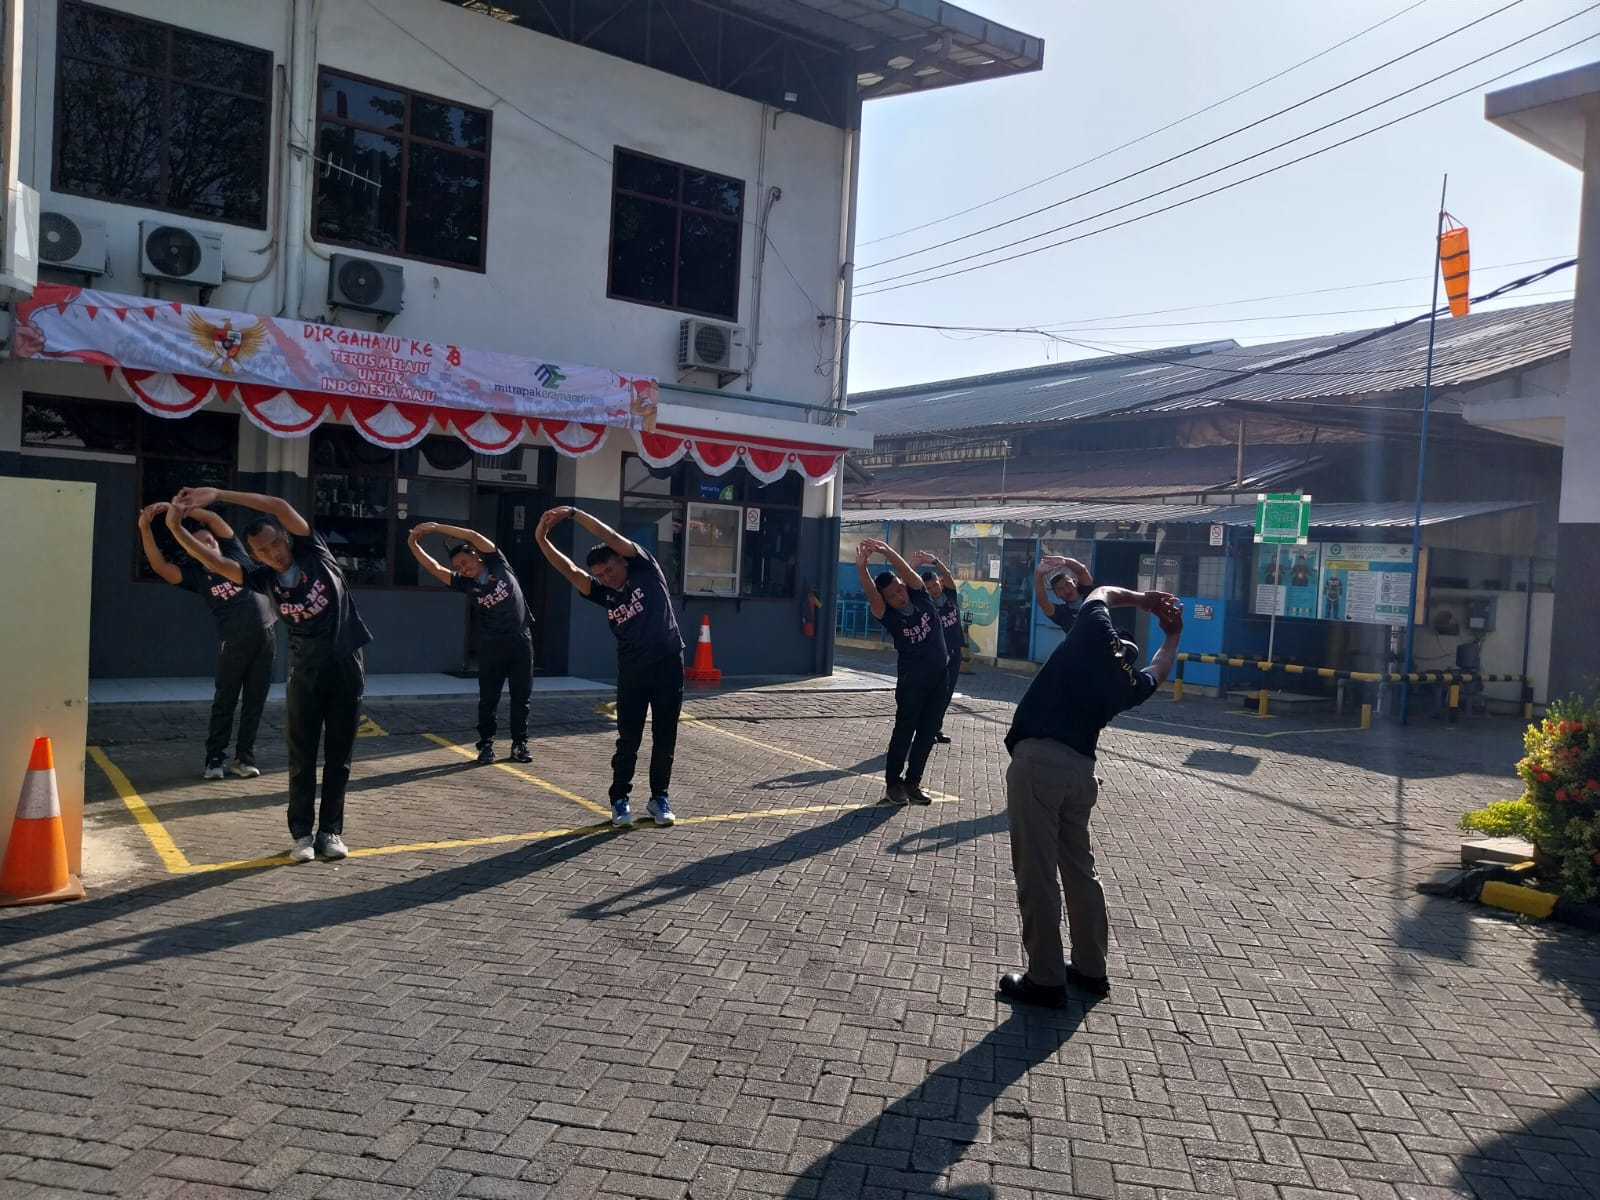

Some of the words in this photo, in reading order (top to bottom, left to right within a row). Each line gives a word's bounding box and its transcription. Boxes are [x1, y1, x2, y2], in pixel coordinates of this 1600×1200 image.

[303, 324, 401, 354] DIRGAHAYU
[410, 340, 433, 358] KE
[330, 349, 377, 368] TERUS
[378, 354, 430, 376] MELAJU
[321, 376, 399, 399] INDONESIA
[400, 388, 437, 403] MAJU
[356, 368, 404, 385] UNTUK
